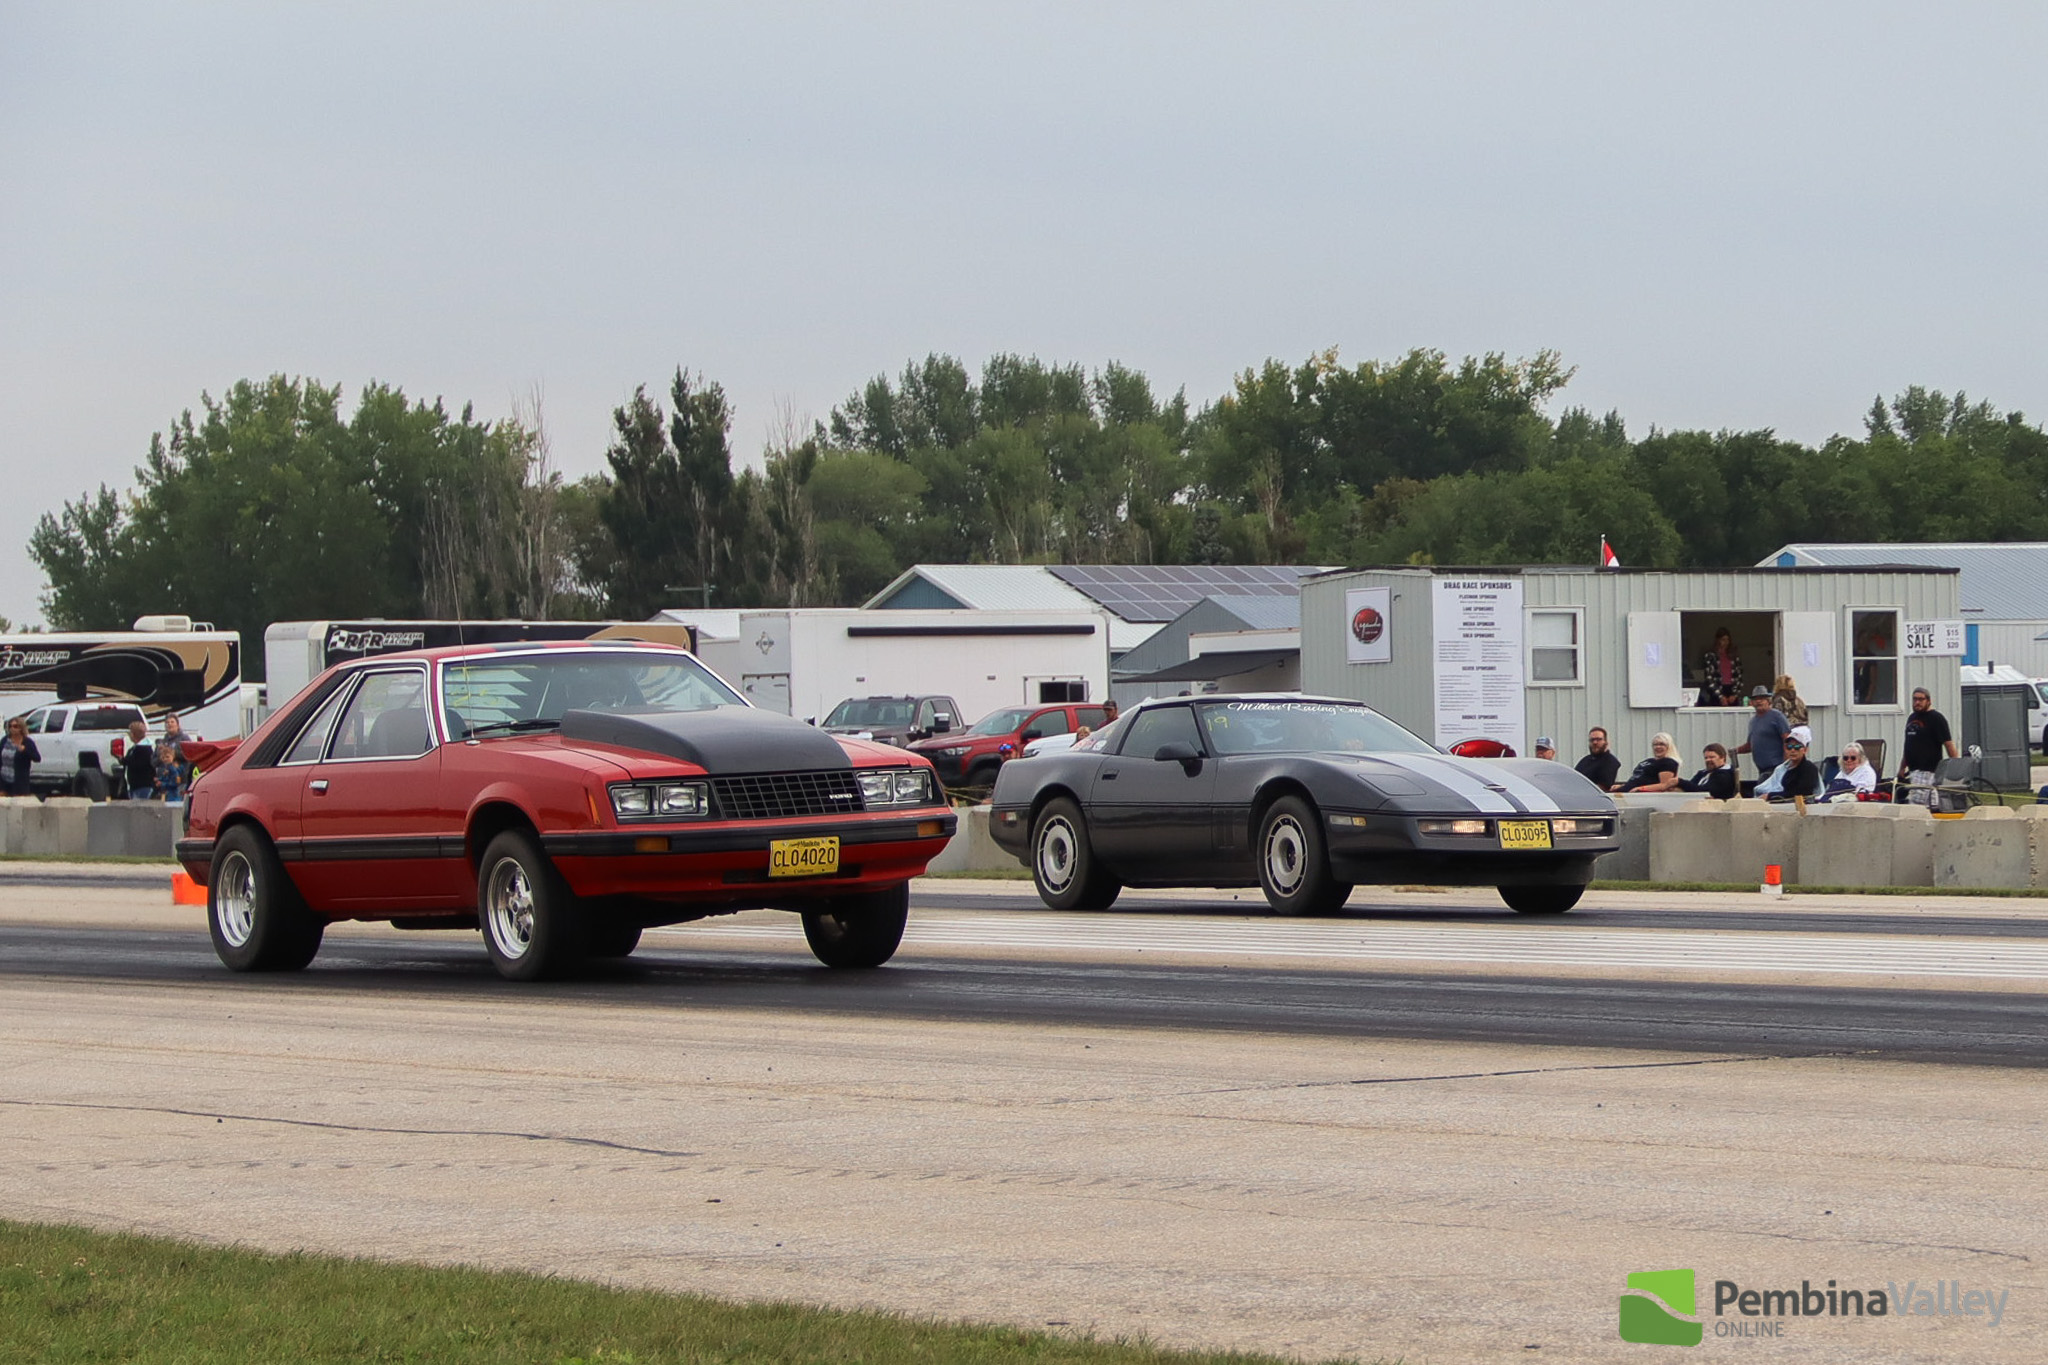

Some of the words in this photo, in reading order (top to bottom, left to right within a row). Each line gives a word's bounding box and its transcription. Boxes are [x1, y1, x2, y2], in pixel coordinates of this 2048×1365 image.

[1443, 581, 1461, 590] DRAG
[1462, 581, 1478, 590] RACE
[1479, 581, 1512, 590] SPONSORS
[1906, 624, 1935, 634] T-SHIRT
[345, 632, 384, 649] RFR
[1907, 634, 1935, 648] SALE
[1947, 641, 1960, 649] $20
[1282, 703, 1337, 715] Racing
[1501, 827, 1548, 842] CL03095
[773, 847, 836, 868] CL04020
